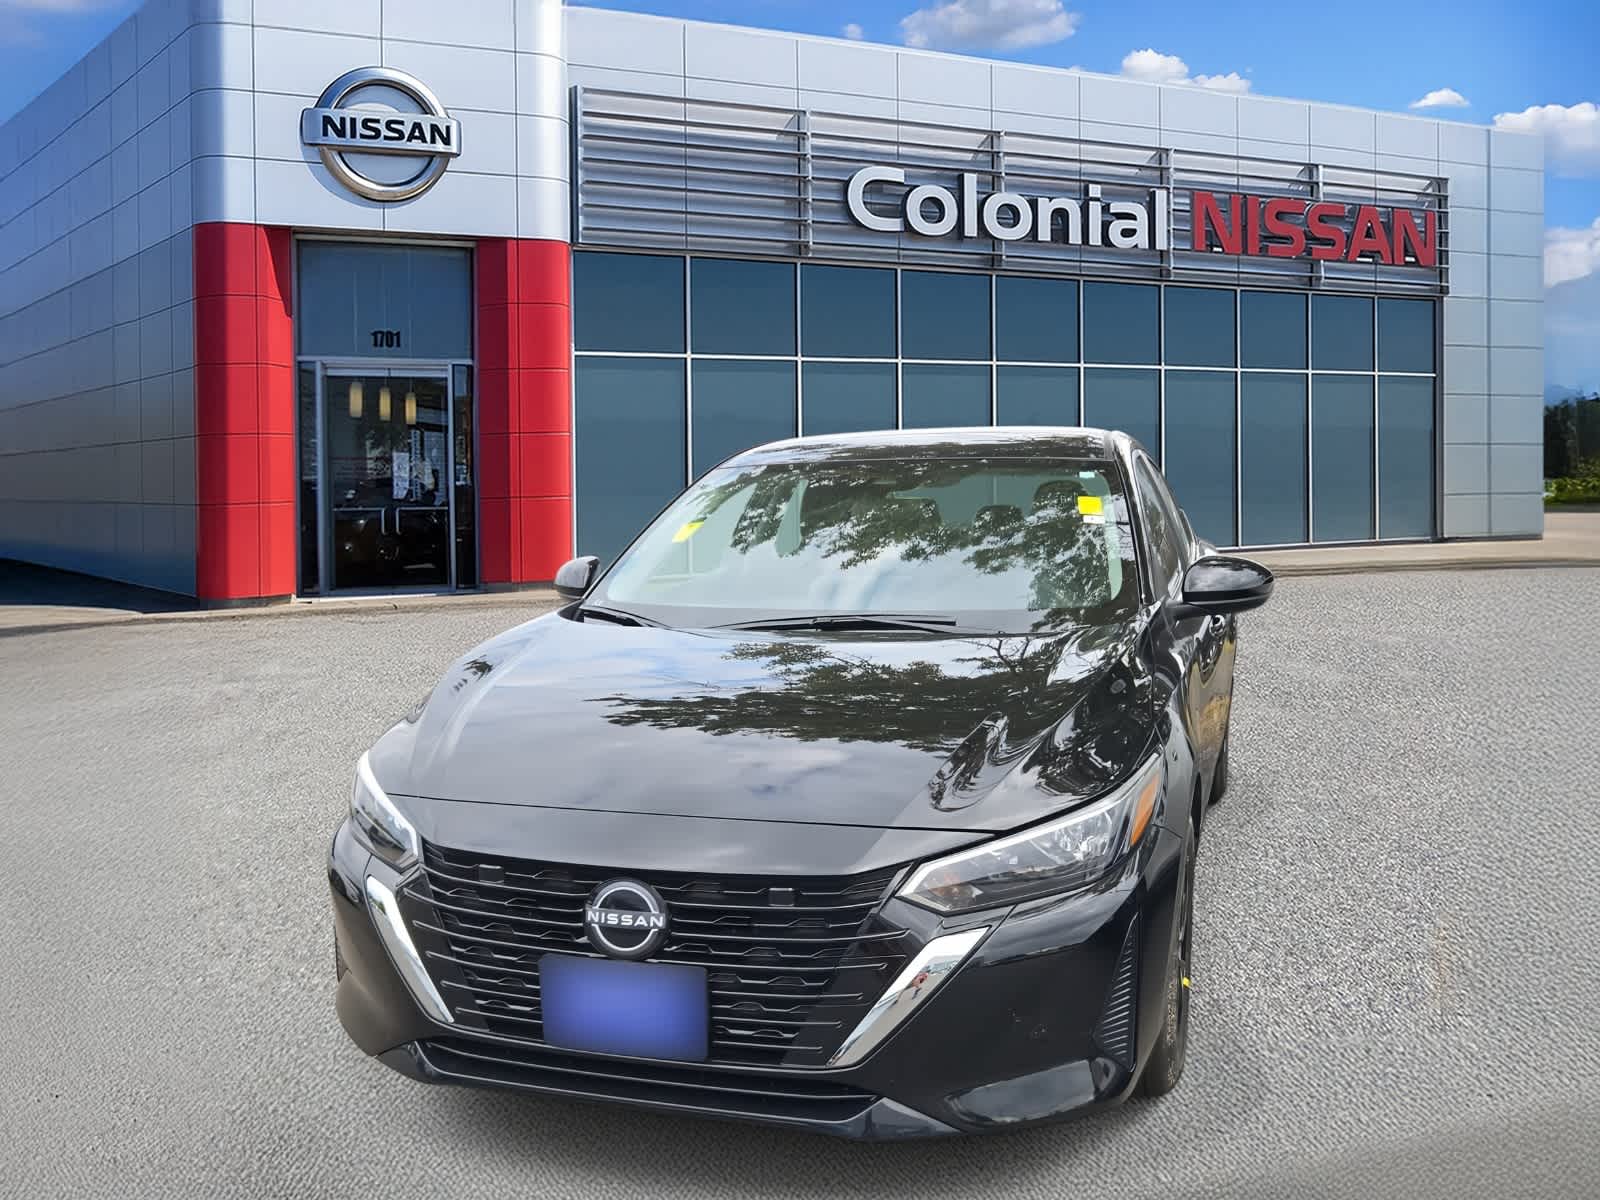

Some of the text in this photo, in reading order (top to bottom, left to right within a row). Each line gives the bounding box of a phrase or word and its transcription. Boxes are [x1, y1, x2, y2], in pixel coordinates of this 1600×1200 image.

[322, 115, 451, 145] NISSAN
[846, 166, 1435, 266] Colonial NISSAN
[371, 330, 401, 347] 1701
[587, 911, 663, 927] NISSAN
